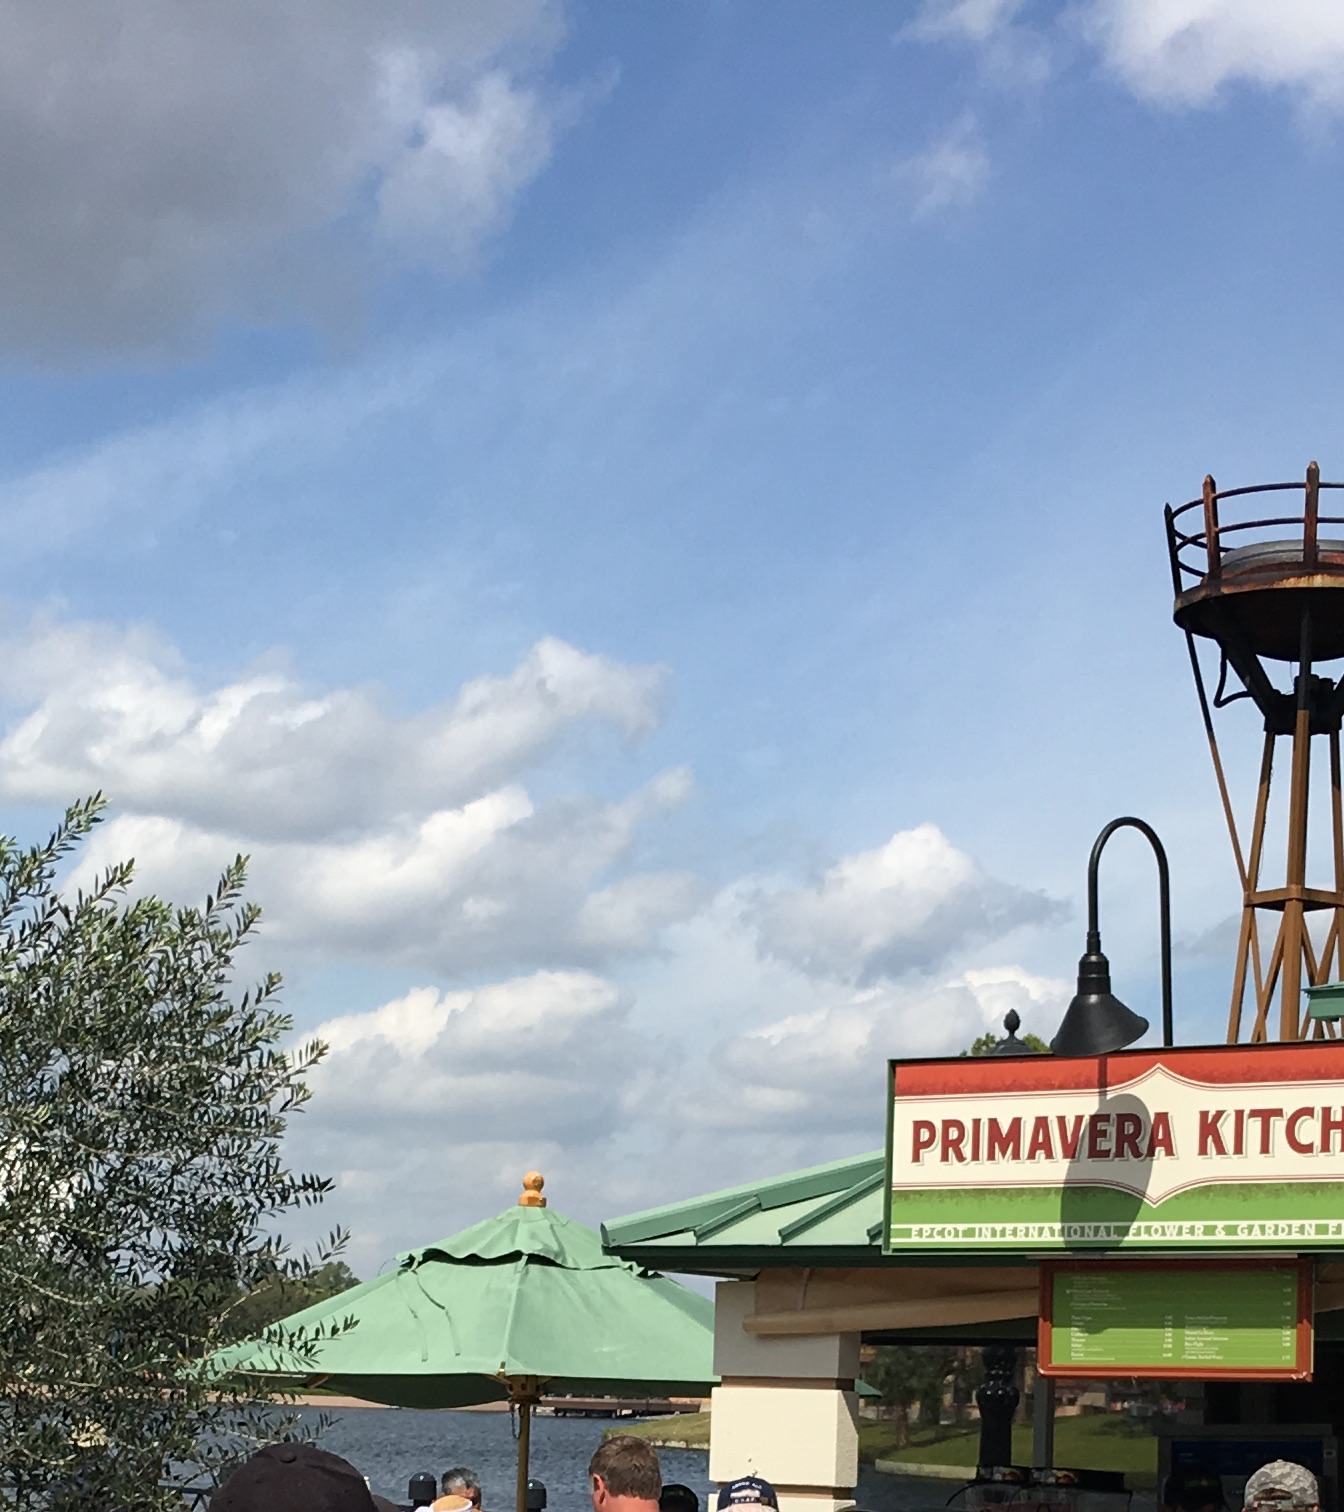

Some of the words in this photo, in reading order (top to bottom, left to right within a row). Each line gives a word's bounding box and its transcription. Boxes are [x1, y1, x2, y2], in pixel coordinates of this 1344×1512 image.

[910, 1112, 1177, 1164] PRIMAVERA
[911, 1226, 968, 1239] EPCOT
[975, 1225, 1118, 1239] INTERNATIONAL
[1129, 1224, 1205, 1238] FLOWER
[1215, 1224, 1226, 1237] &
[1237, 1223, 1316, 1237] GARDEN
